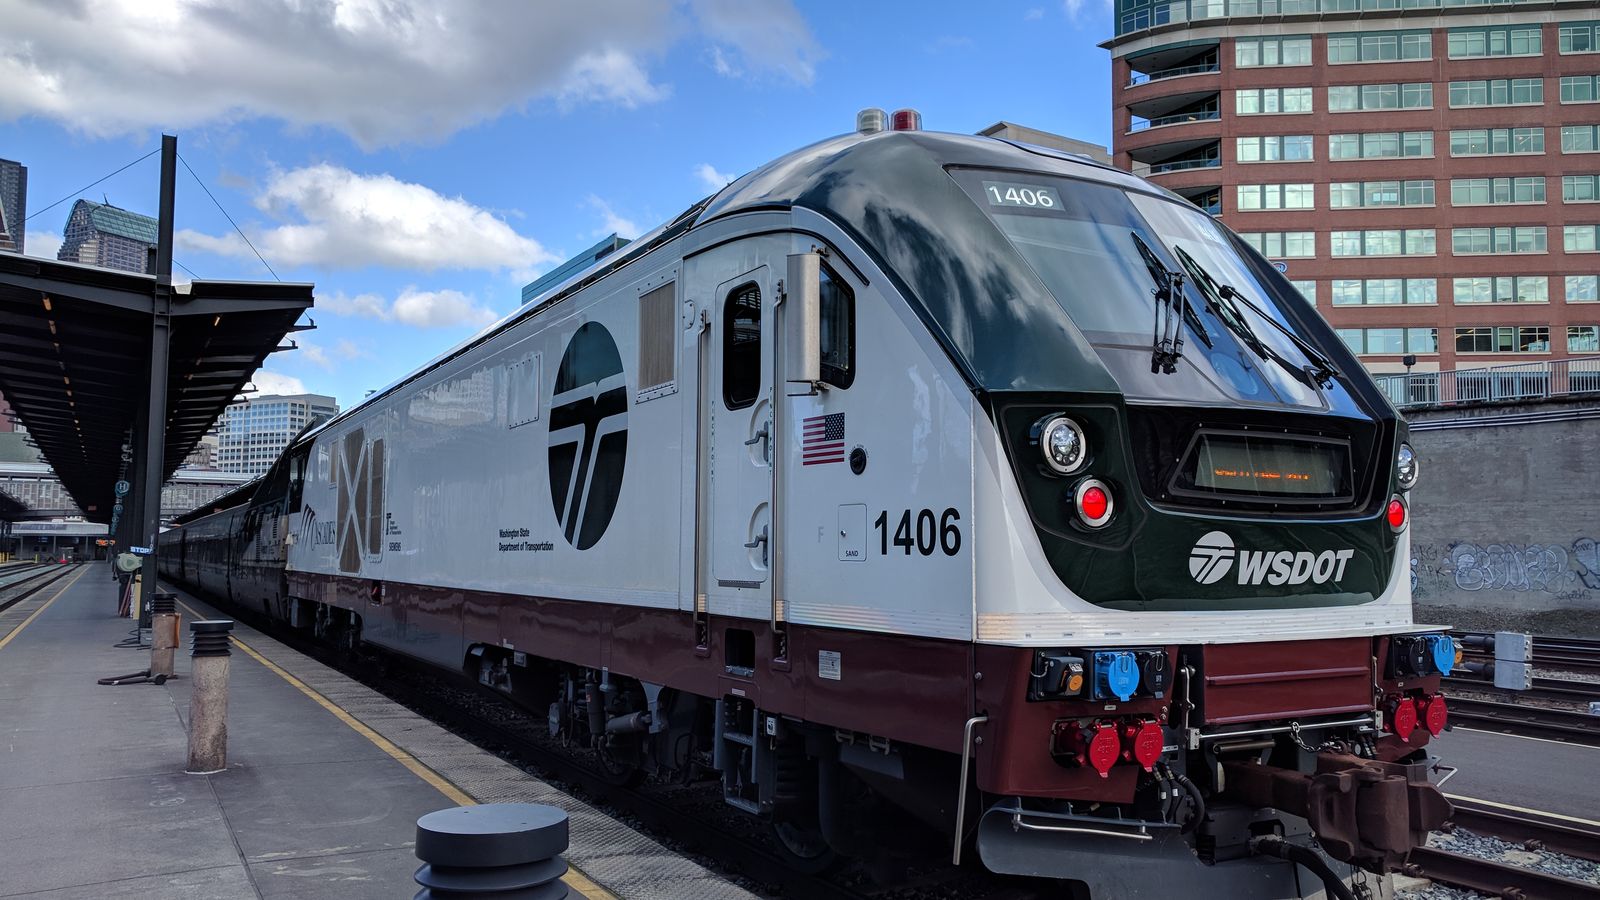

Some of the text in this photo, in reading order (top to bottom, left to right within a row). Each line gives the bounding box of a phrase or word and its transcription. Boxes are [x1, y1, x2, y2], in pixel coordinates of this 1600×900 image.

[989, 185, 1054, 208] 1406
[499, 528, 530, 539] Washington State
[874, 507, 962, 557] 1406
[498, 541, 554, 553] Department of Transportation
[1237, 548, 1355, 586] WSDOT
